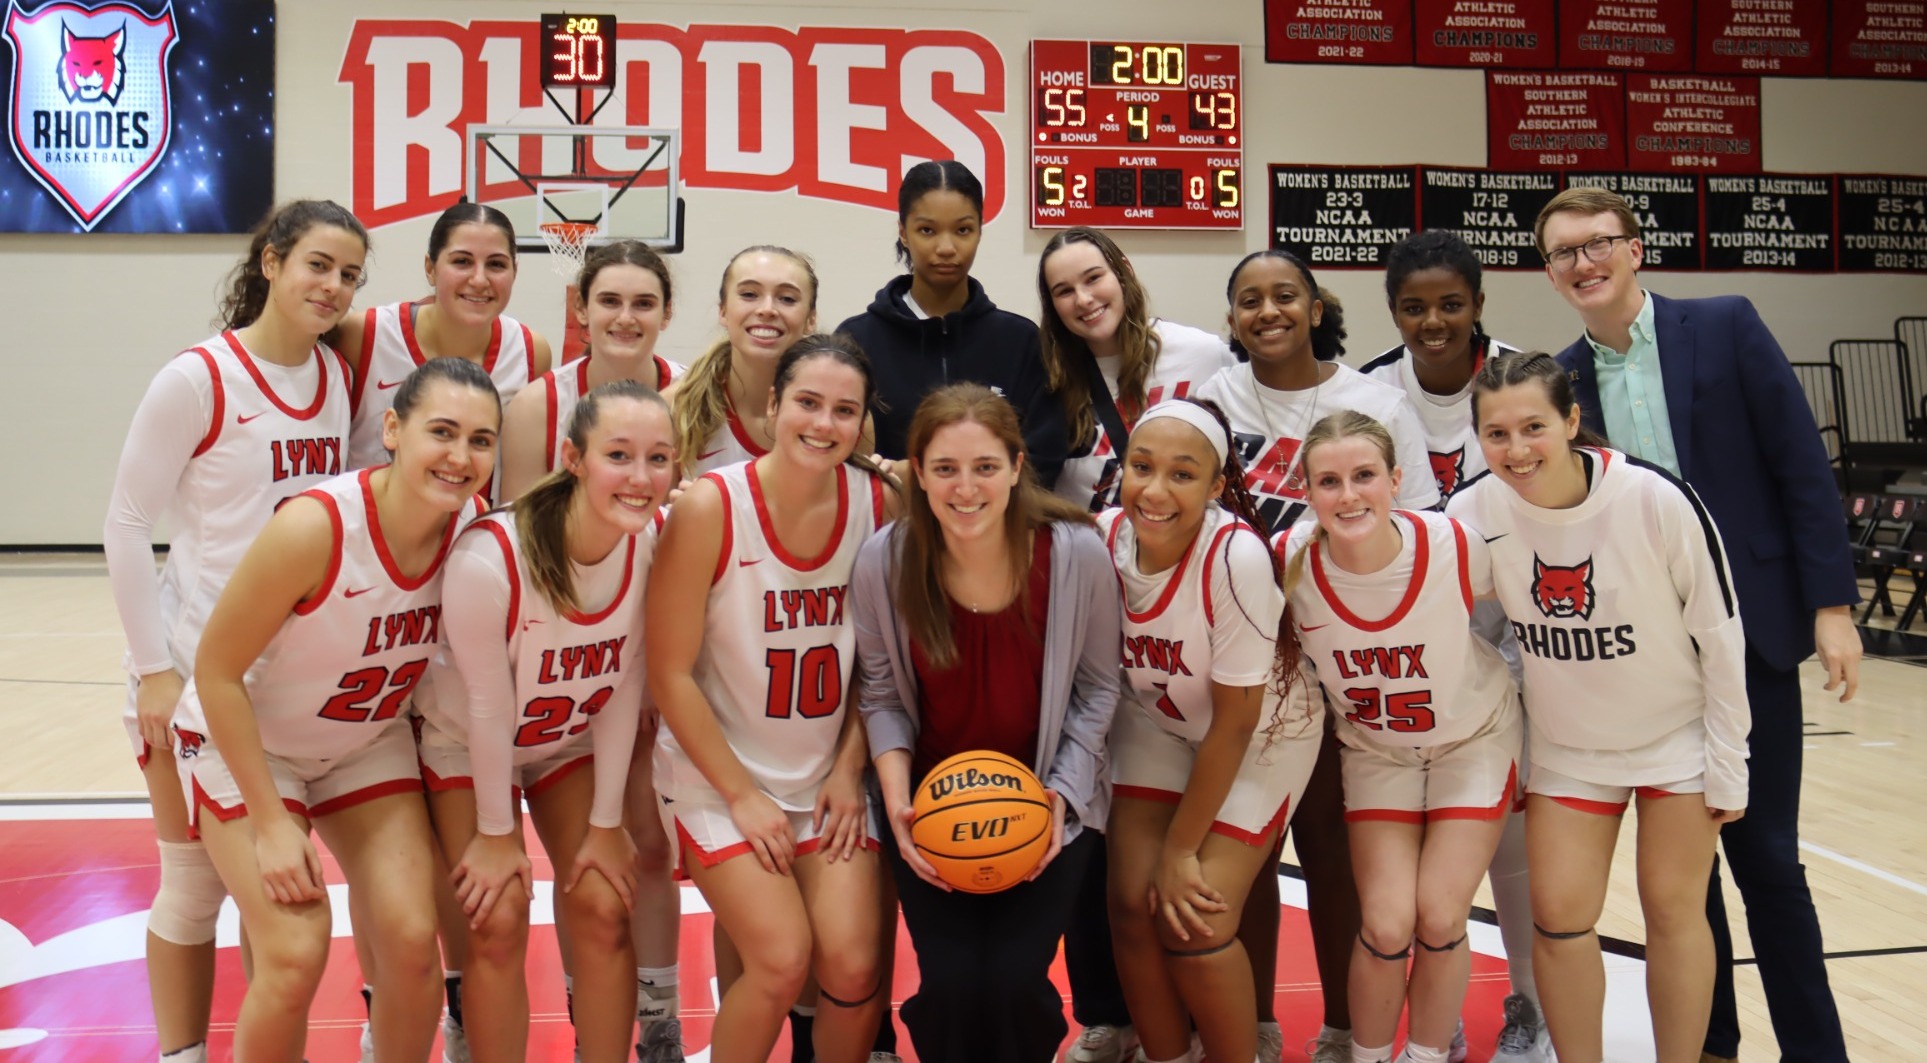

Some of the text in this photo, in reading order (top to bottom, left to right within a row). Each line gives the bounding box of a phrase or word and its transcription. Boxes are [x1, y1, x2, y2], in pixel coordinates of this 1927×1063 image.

[1454, 2, 1516, 14] ATHLETIC
[1596, 5, 1658, 19] ATHLETIC
[1731, 0, 1793, 10] SOUTHERN
[1865, 3, 1924, 14] SOUTHERN
[1296, 7, 1383, 20] ASSOCIATION
[1733, 13, 1792, 24] ATHLETIC
[566, 18, 598, 34] 2:00
[1445, 15, 1526, 29] ASSOCIATION
[1587, 19, 1666, 34] ASSOCIATION
[1866, 16, 1923, 28] ATHLETIC
[1287, 22, 1393, 42] CHAMPIONS
[1434, 29, 1537, 49] CHAMPIONS
[1723, 26, 1801, 38] ASSOCIATION
[1318, 46, 1364, 57] 2021-22
[1578, 34, 1675, 54] CHAMPIONS
[1713, 38, 1810, 57] CHAMPIONS
[553, 34, 603, 81] 30
[1469, 51, 1503, 63] 2020-21
[1112, 46, 1183, 85] 2:00
[1040, 71, 1084, 86] HOME
[1188, 75, 1236, 90] GUEST
[1493, 74, 1618, 86] WOMEN'S BASKETBALL
[1650, 78, 1736, 92] BASKETBALL
[1116, 91, 1160, 102] PERIOD
[1524, 89, 1588, 100] SOUTHERN
[1675, 92, 1757, 107] INTERCOLLEGIATE
[1044, 89, 1086, 127] 55
[1195, 92, 1236, 130] 43
[1526, 104, 1587, 115] ATHLETIC
[1663, 107, 1724, 120] ATHLETIC
[33, 110, 149, 149] RHODES
[364, 34, 986, 211] RHODES
[1099, 123, 1120, 132] POSS
[1127, 106, 1149, 140] 4
[1155, 124, 1176, 133] POSS
[1517, 119, 1597, 130] ASSOCIATION
[1653, 122, 1734, 135] CONFERENCE
[1061, 133, 1097, 143] BONUS
[1178, 135, 1215, 144] BONUS
[1509, 133, 1608, 151] CHAMPIONS
[1636, 135, 1751, 154] CHAMPIONS
[45, 152, 136, 163] BASKETBALL
[1035, 155, 1069, 165] FOULS
[1119, 156, 1157, 166] PLAYER
[1207, 158, 1240, 168] FOULS
[1539, 154, 1578, 165] 2012-13
[1043, 167, 1065, 206] 5
[1072, 174, 1087, 199] 2
[1189, 176, 1204, 200] 0
[1217, 169, 1238, 207] 5
[1277, 172, 1411, 189] WOMEN'S BASKETBALL
[1426, 171, 1554, 190] WOMEN'S BASKETBALL
[1568, 175, 1694, 193] WOMEN'S BASKETBALL
[1708, 178, 1828, 195] WOMEN'S BASKETBALL
[1844, 178, 1927, 196] WOMEN'S BASKE
[1069, 201, 1092, 209] T.O.L.
[1186, 202, 1209, 211] T.O.L.
[1326, 192, 1363, 207] 23-3
[1473, 192, 1509, 208] 17-12
[1619, 194, 1650, 210] 0-9
[1752, 196, 1786, 212] 25-4
[1878, 198, 1925, 215] 25-4
[1038, 207, 1065, 217] WON
[1124, 209, 1154, 218] GAME
[1213, 210, 1239, 219] WON
[1316, 210, 1373, 225] NCAA
[1463, 211, 1518, 227] NCAA
[1744, 214, 1795, 230] NCAA
[1874, 216, 1927, 232] NCAA
[1276, 227, 1411, 244] TOURNAMENT
[1709, 232, 1829, 249] TOURNAMENT
[1311, 246, 1379, 262] 2021-22
[1473, 249, 1518, 265] 018-19
[1743, 250, 1796, 266] 2013-14
[270, 436, 341, 483] LYNX
[763, 583, 848, 633] LYNX
[361, 603, 442, 658] LYNX
[1510, 619, 1637, 661] RHODES
[537, 634, 628, 685] LYNX
[1120, 630, 1193, 677] LYNX
[1332, 643, 1429, 680] LYNX
[764, 643, 842, 720] 10
[1343, 686, 1436, 733] 25
[929, 768, 1023, 801] Wilson
[951, 817, 1010, 842] EVO
